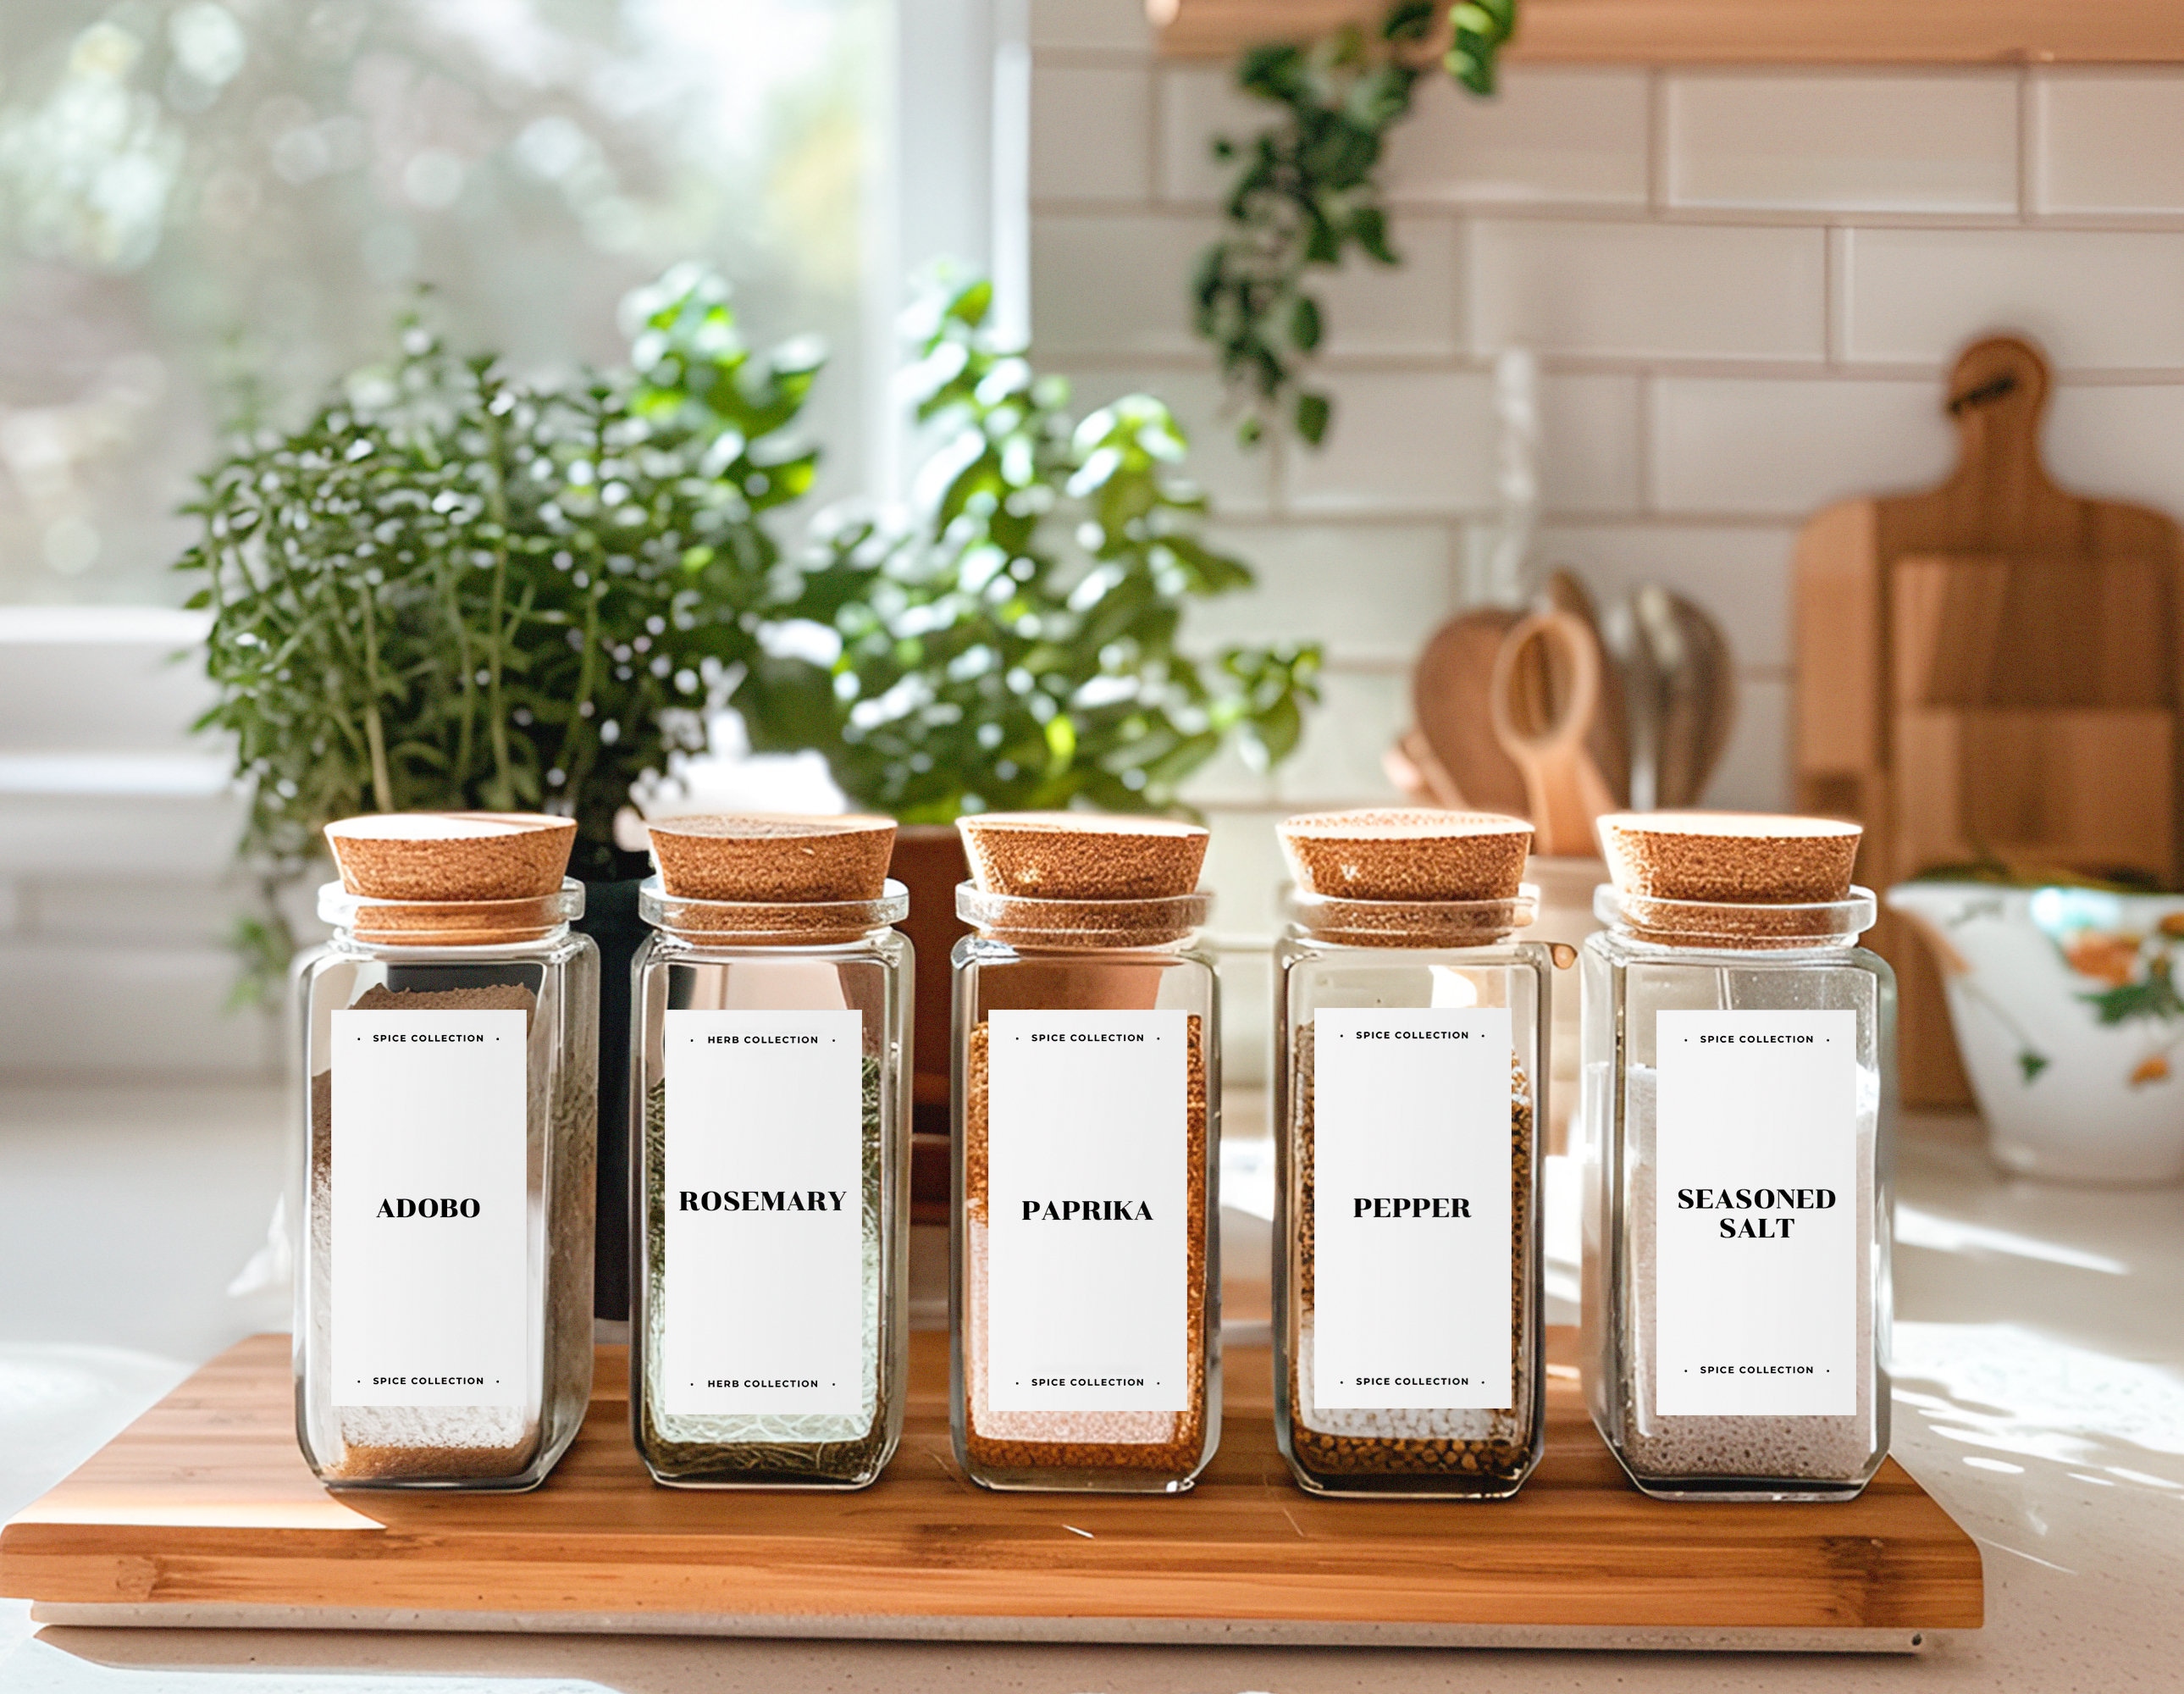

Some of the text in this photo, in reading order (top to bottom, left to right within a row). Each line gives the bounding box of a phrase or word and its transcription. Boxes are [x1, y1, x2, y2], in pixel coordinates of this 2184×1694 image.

[373, 1033, 484, 1043] SPICE COLLECTION
[707, 1035, 818, 1044] HERB COLLECTION
[1031, 1033, 1144, 1043] SPICE COLLECTION
[1356, 1031, 1469, 1040] SPICE COLLECTION
[1700, 1035, 1814, 1044] SPICE COLLECTION
[678, 1190, 848, 1212] ROSEMARY
[1678, 1188, 1837, 1210] SEASONED
[375, 1198, 481, 1219] ADOBO
[1021, 1199, 1154, 1221] PAPRIKA
[1352, 1198, 1473, 1219] PEPPER
[1719, 1217, 1795, 1239] SALT
[1700, 1365, 1814, 1375] SPICE COLLECTION
[373, 1376, 484, 1386] SPICE COLLECTION
[707, 1379, 818, 1388] HERB COLLECTION
[1031, 1378, 1144, 1387] SPICE COLLECTION
[1356, 1377, 1469, 1386] SPICE COLLECTION
